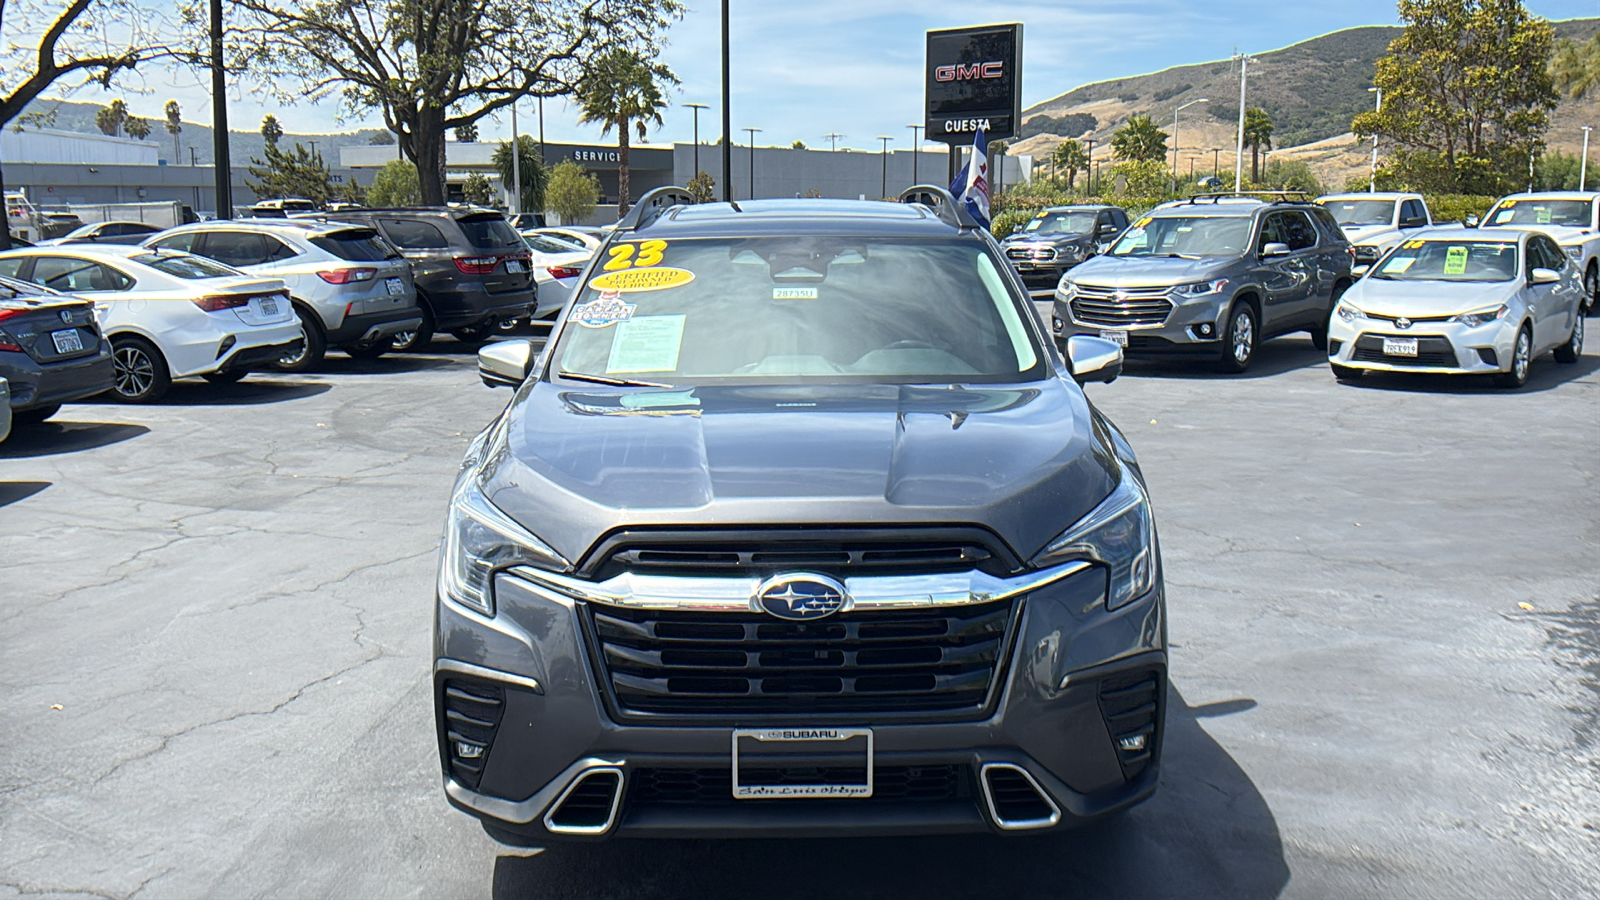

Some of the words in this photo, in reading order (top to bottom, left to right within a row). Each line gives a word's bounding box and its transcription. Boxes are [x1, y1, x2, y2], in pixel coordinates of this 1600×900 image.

[935, 60, 1003, 82] GMC
[945, 118, 991, 132] CUESTA
[603, 240, 668, 271] 23
[605, 271, 679, 281] CERTIFIED
[776, 290, 813, 298] 28735U
[782, 730, 838, 739] SUBARU
[738, 786, 775, 796] San
[778, 787, 817, 795] Luis
[820, 785, 868, 797] Obispo
